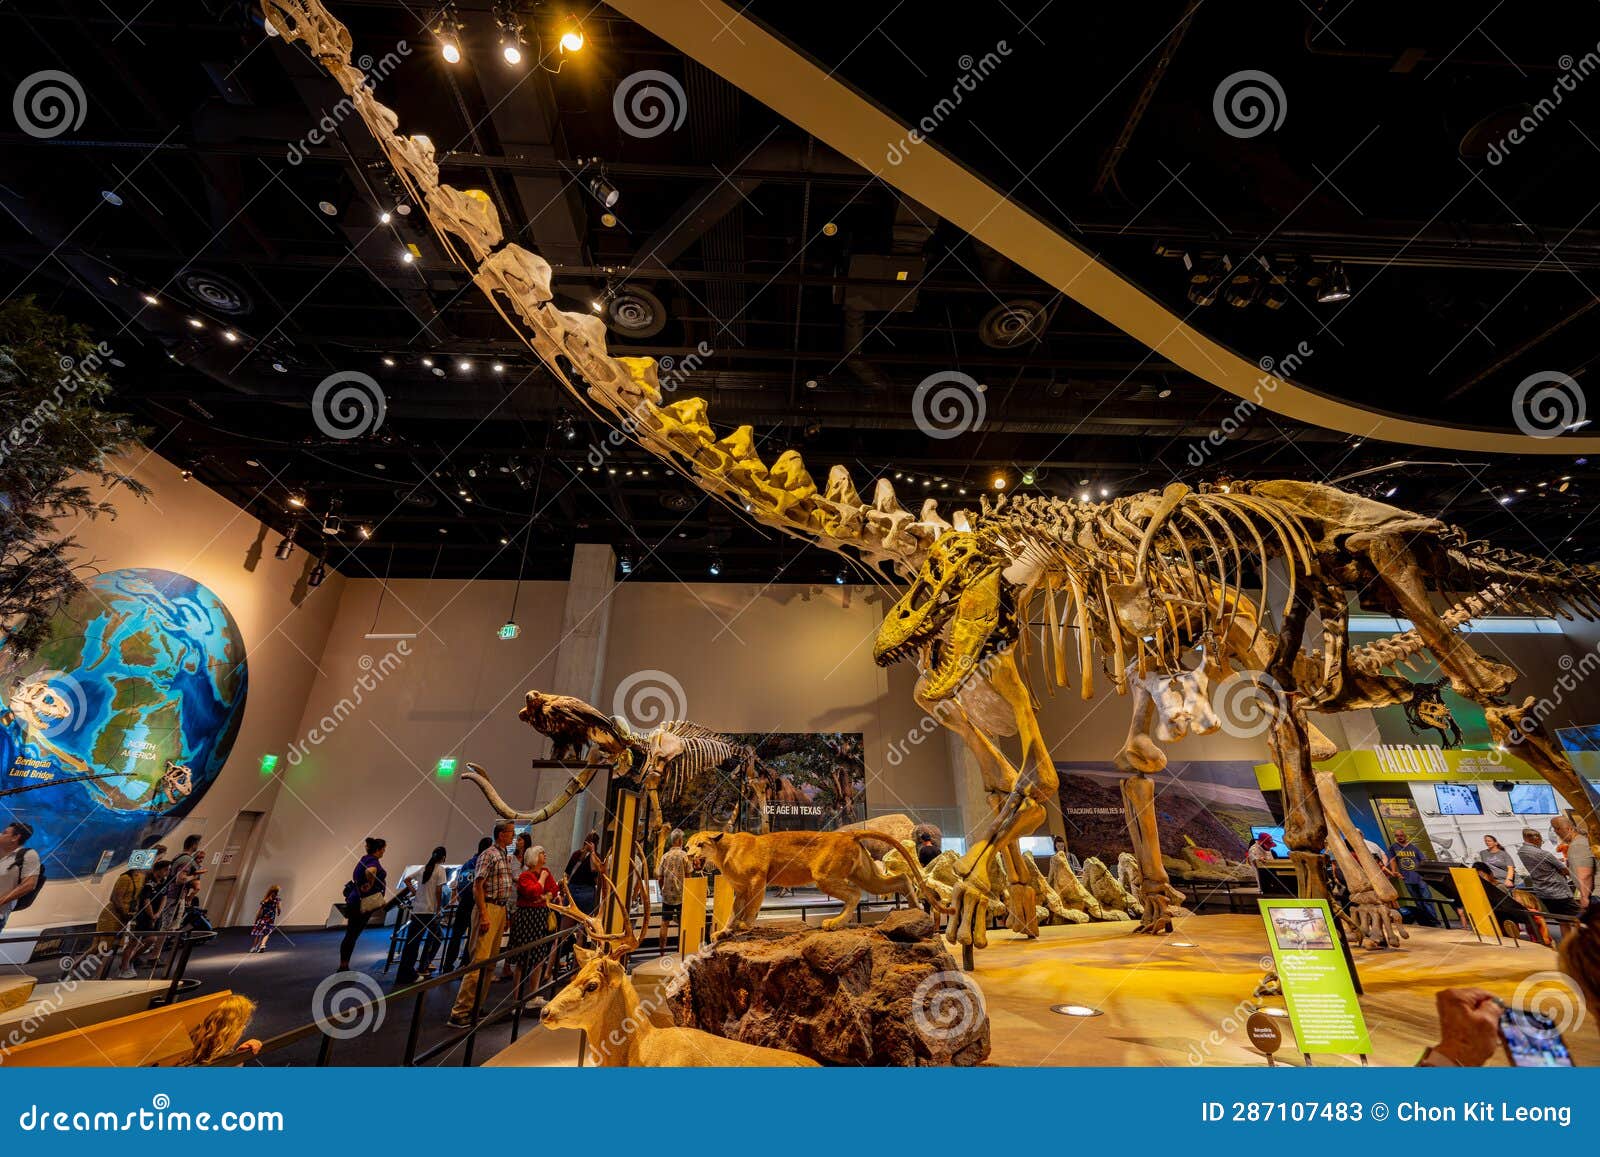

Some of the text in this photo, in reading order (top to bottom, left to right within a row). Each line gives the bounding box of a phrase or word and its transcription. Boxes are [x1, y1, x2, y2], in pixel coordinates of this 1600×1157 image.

[1373, 743, 1449, 773] PALEO LAB
[9, 768, 55, 780] Land Bridge
[763, 805, 822, 816] ICE AGE IN TEXAS
[1067, 807, 1093, 815] TRACKING
[1094, 807, 1118, 815] FAMILIES
